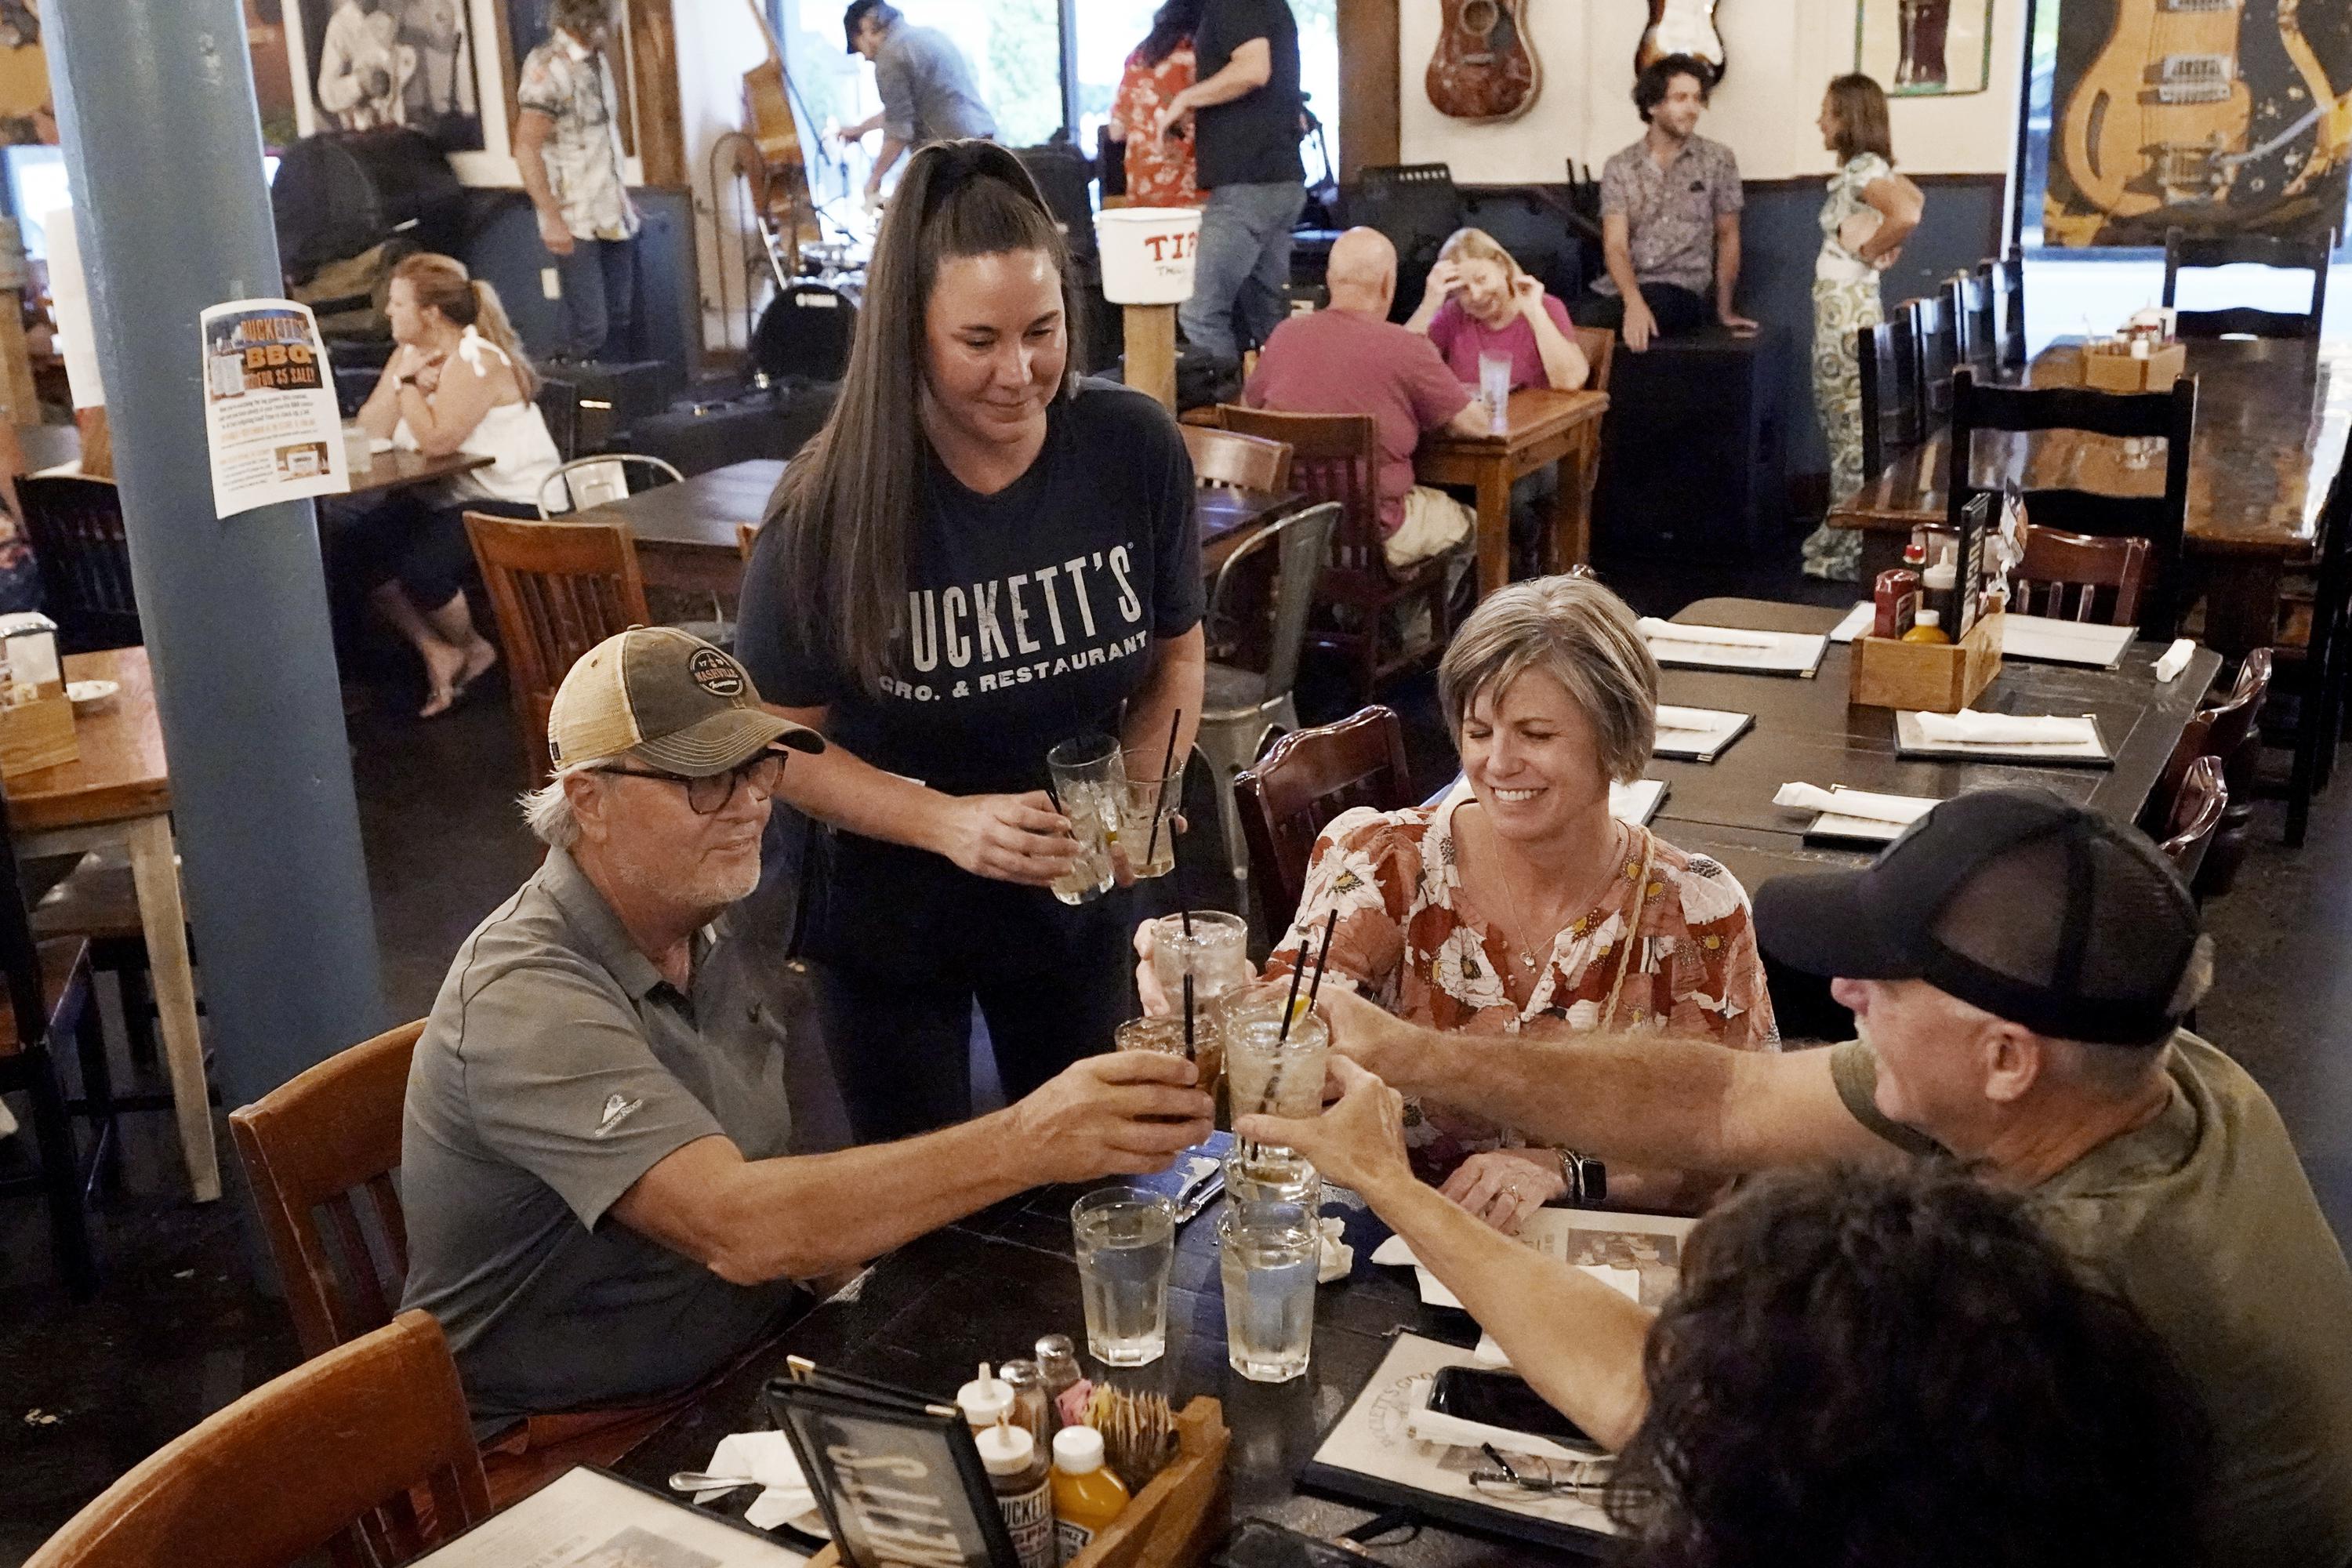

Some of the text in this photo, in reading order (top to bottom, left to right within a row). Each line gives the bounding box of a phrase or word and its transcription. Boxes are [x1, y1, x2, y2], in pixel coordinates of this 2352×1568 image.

[245, 344, 312, 368] BBQ
[908, 545, 1142, 673] UCKETT'S
[694, 668, 739, 682] NASHVILLE
[952, 680, 971, 699] &
[980, 630, 1148, 693] RESTAURANT
